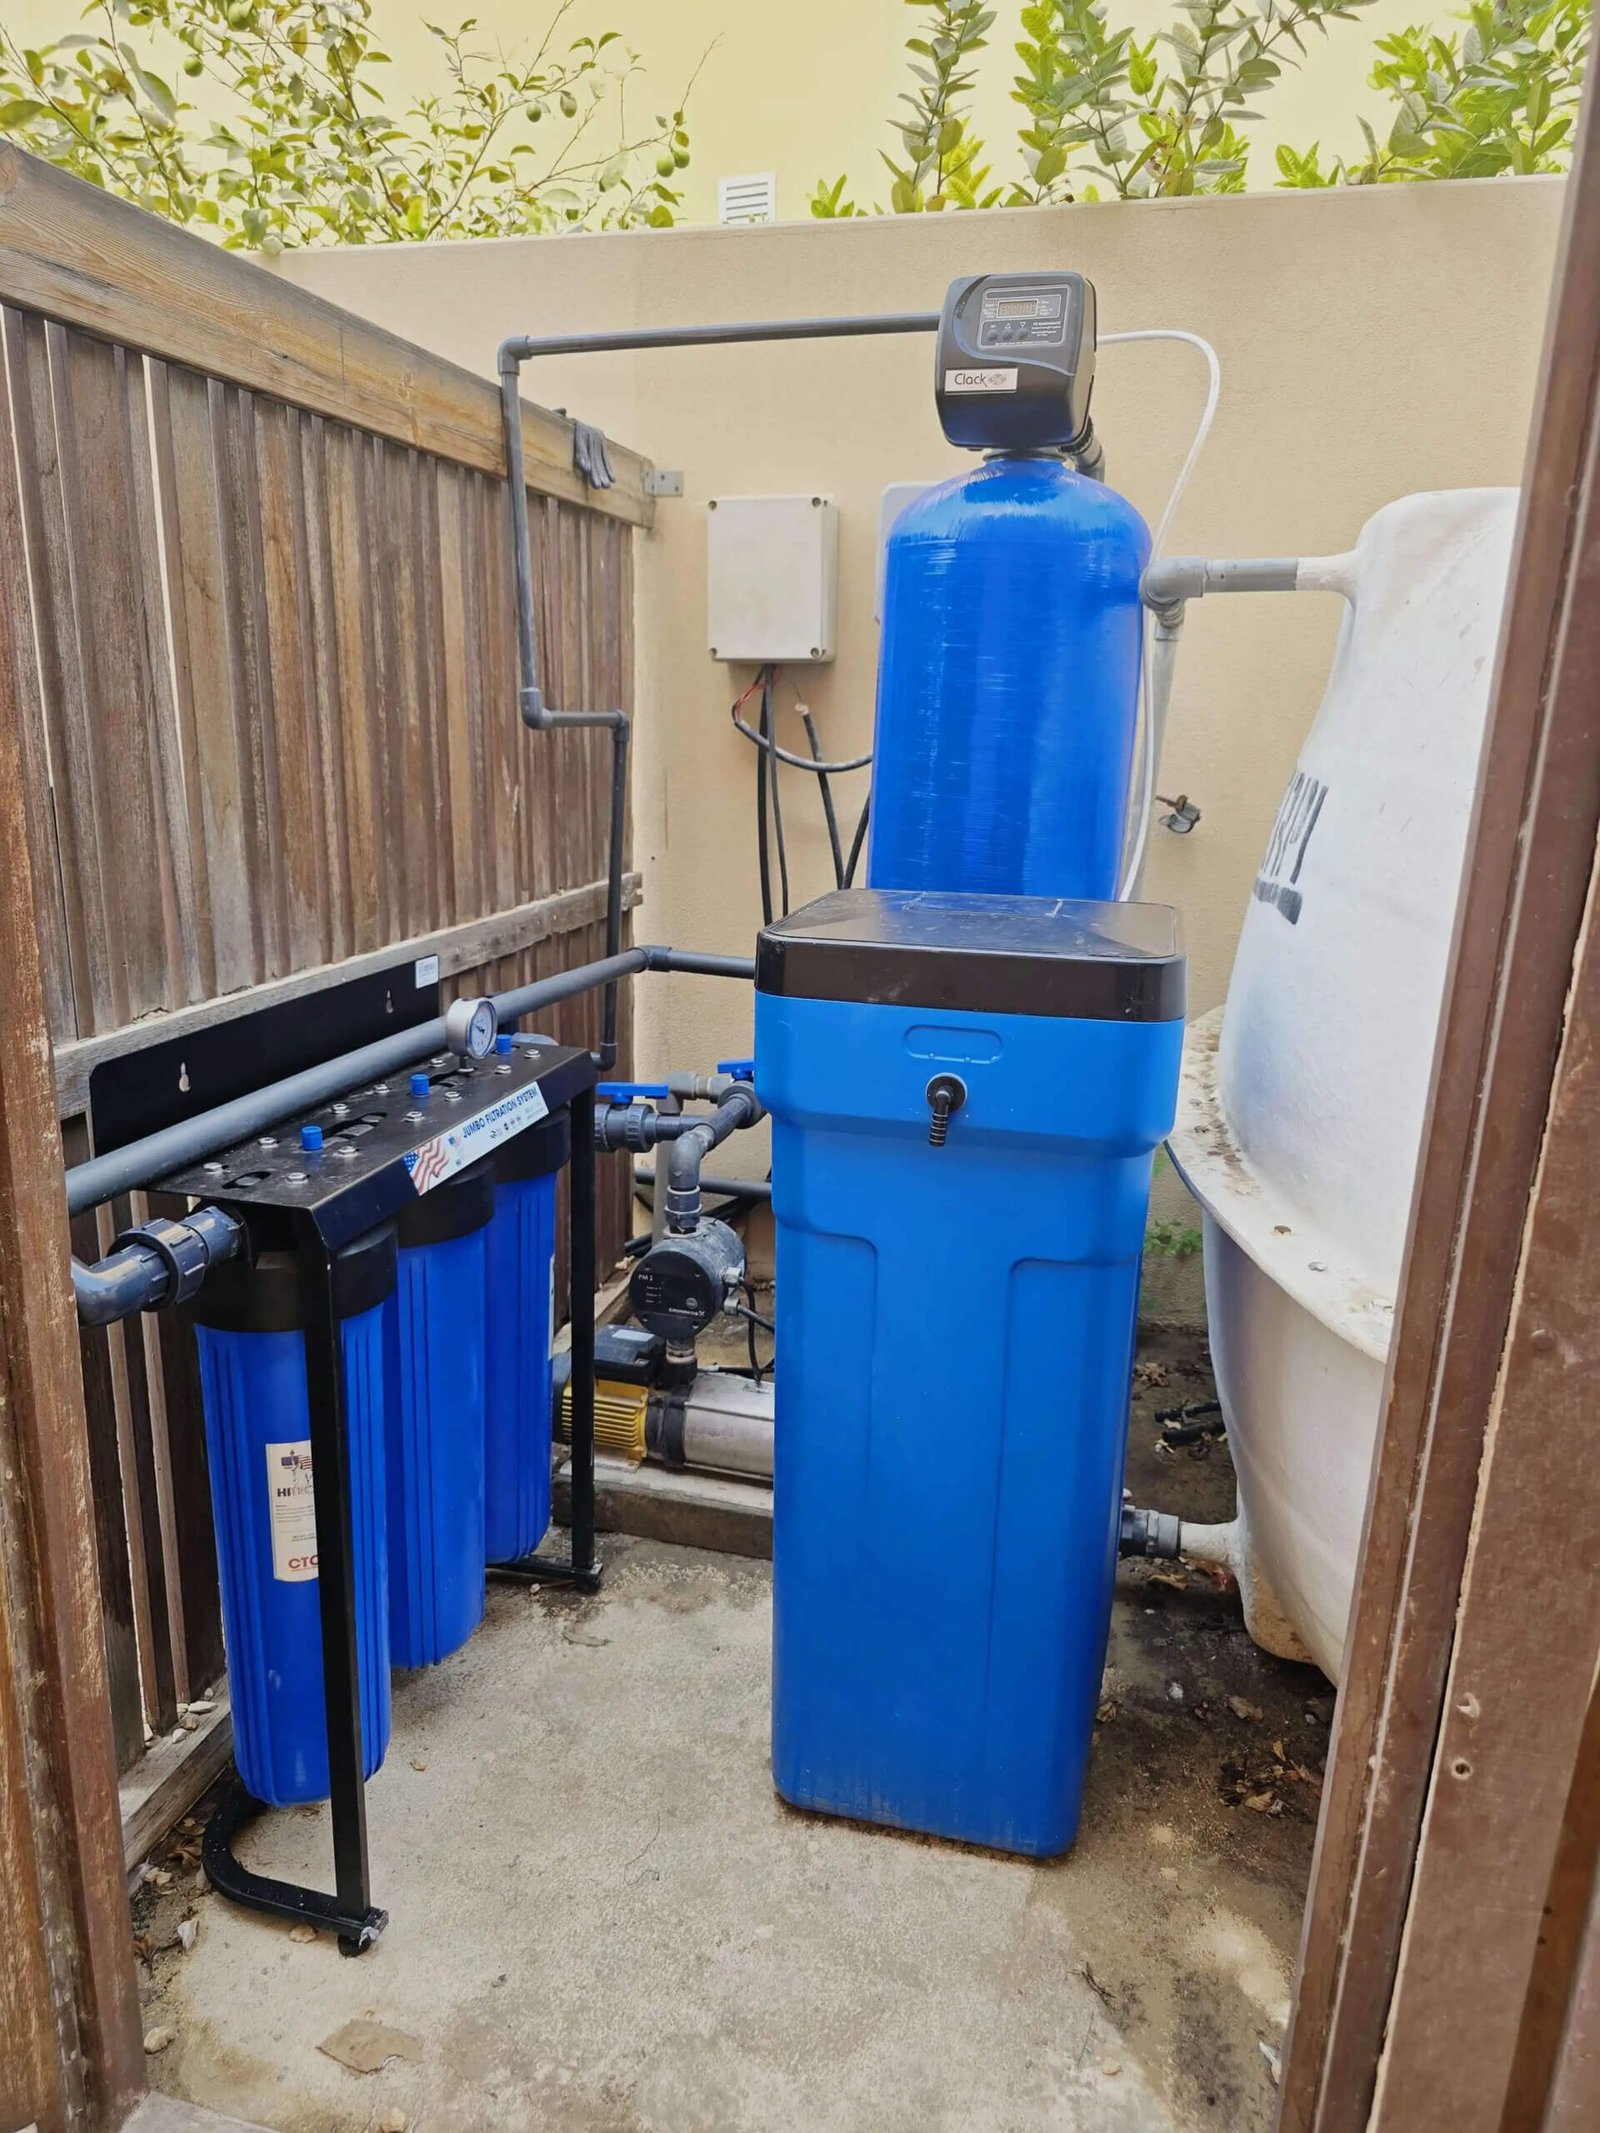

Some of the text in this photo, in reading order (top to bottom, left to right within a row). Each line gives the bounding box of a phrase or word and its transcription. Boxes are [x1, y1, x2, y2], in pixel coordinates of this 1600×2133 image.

[954, 373, 988, 387] Clack
[462, 1118, 486, 1139] JUMBO
[485, 1100, 518, 1125] FILTRATION
[516, 1087, 538, 1106] SYSTEM
